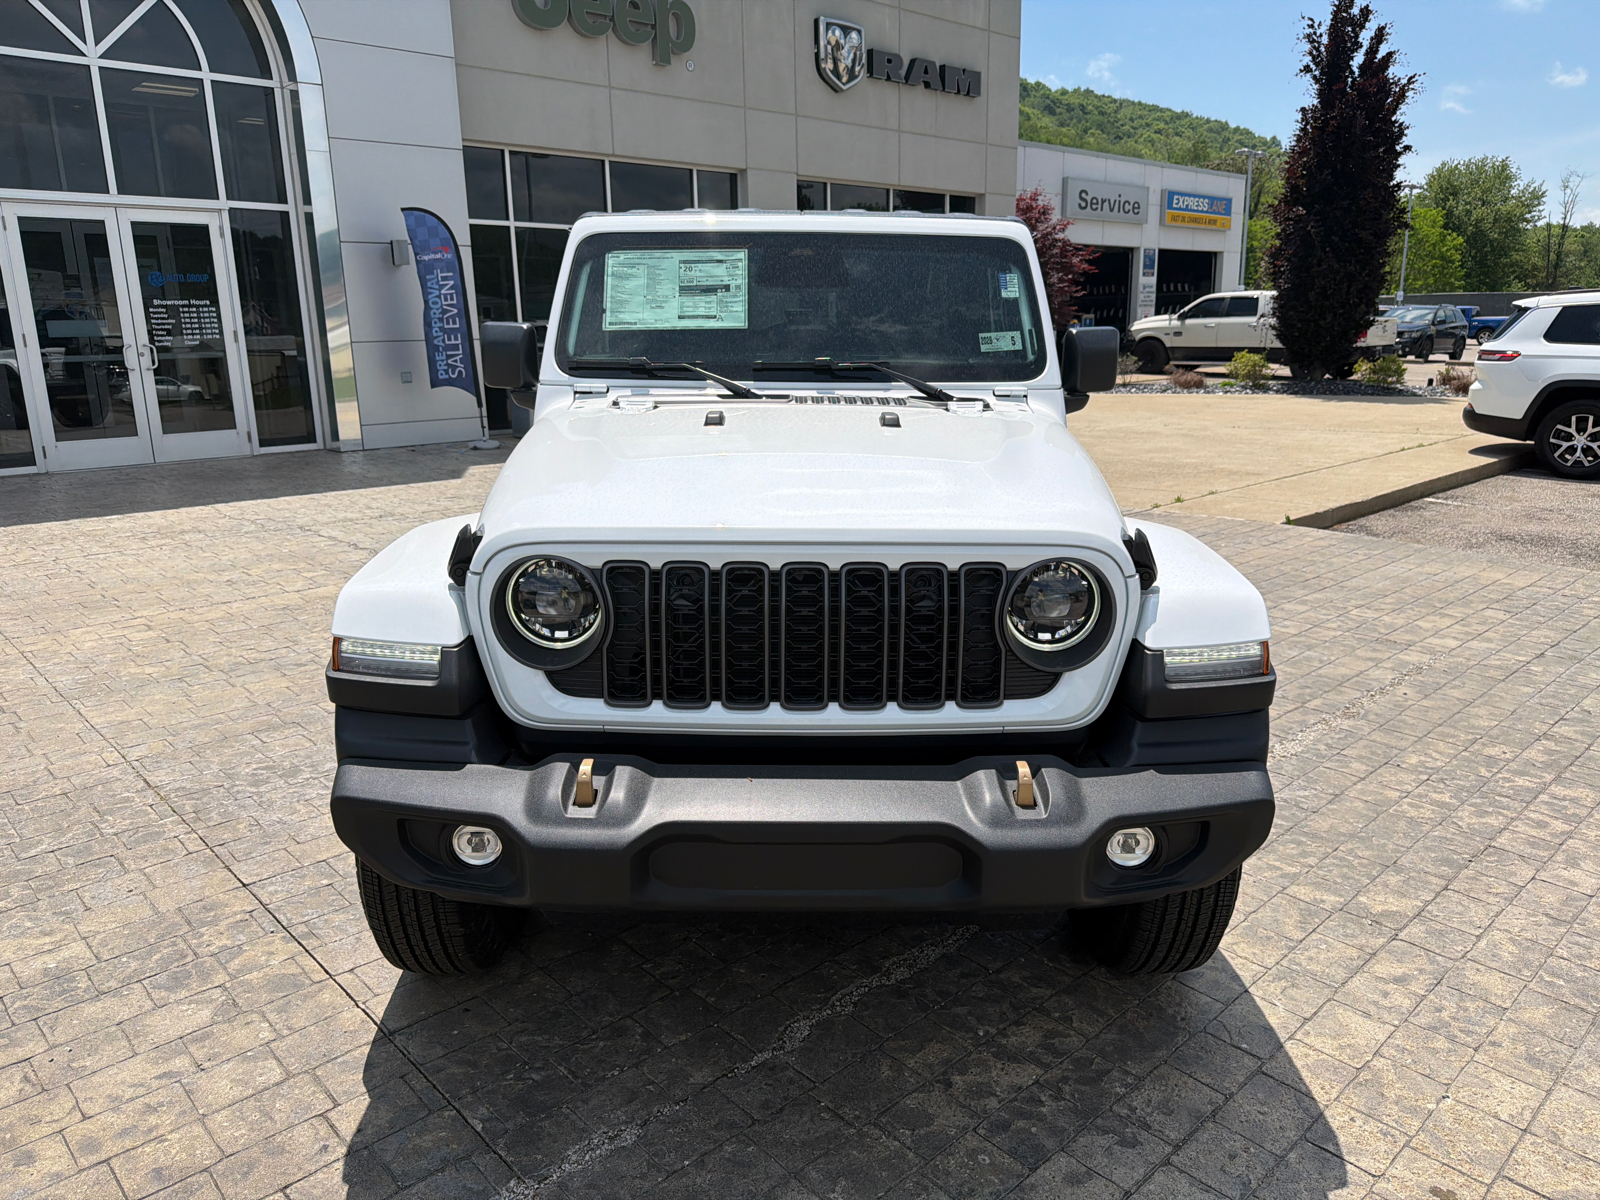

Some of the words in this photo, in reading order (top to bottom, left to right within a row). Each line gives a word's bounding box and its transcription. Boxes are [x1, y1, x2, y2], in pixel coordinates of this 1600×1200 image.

[867, 48, 982, 98] RAM
[1078, 189, 1141, 215] Service
[1187, 216, 1204, 224] CHANGES
[167, 274, 184, 282] AUTO
[187, 274, 209, 282] GROUP
[438, 269, 460, 328] EVENT
[426, 269, 448, 380] PRE-APPROVAL
[1011, 336, 1016, 346] 5
[445, 333, 466, 378] SALE
